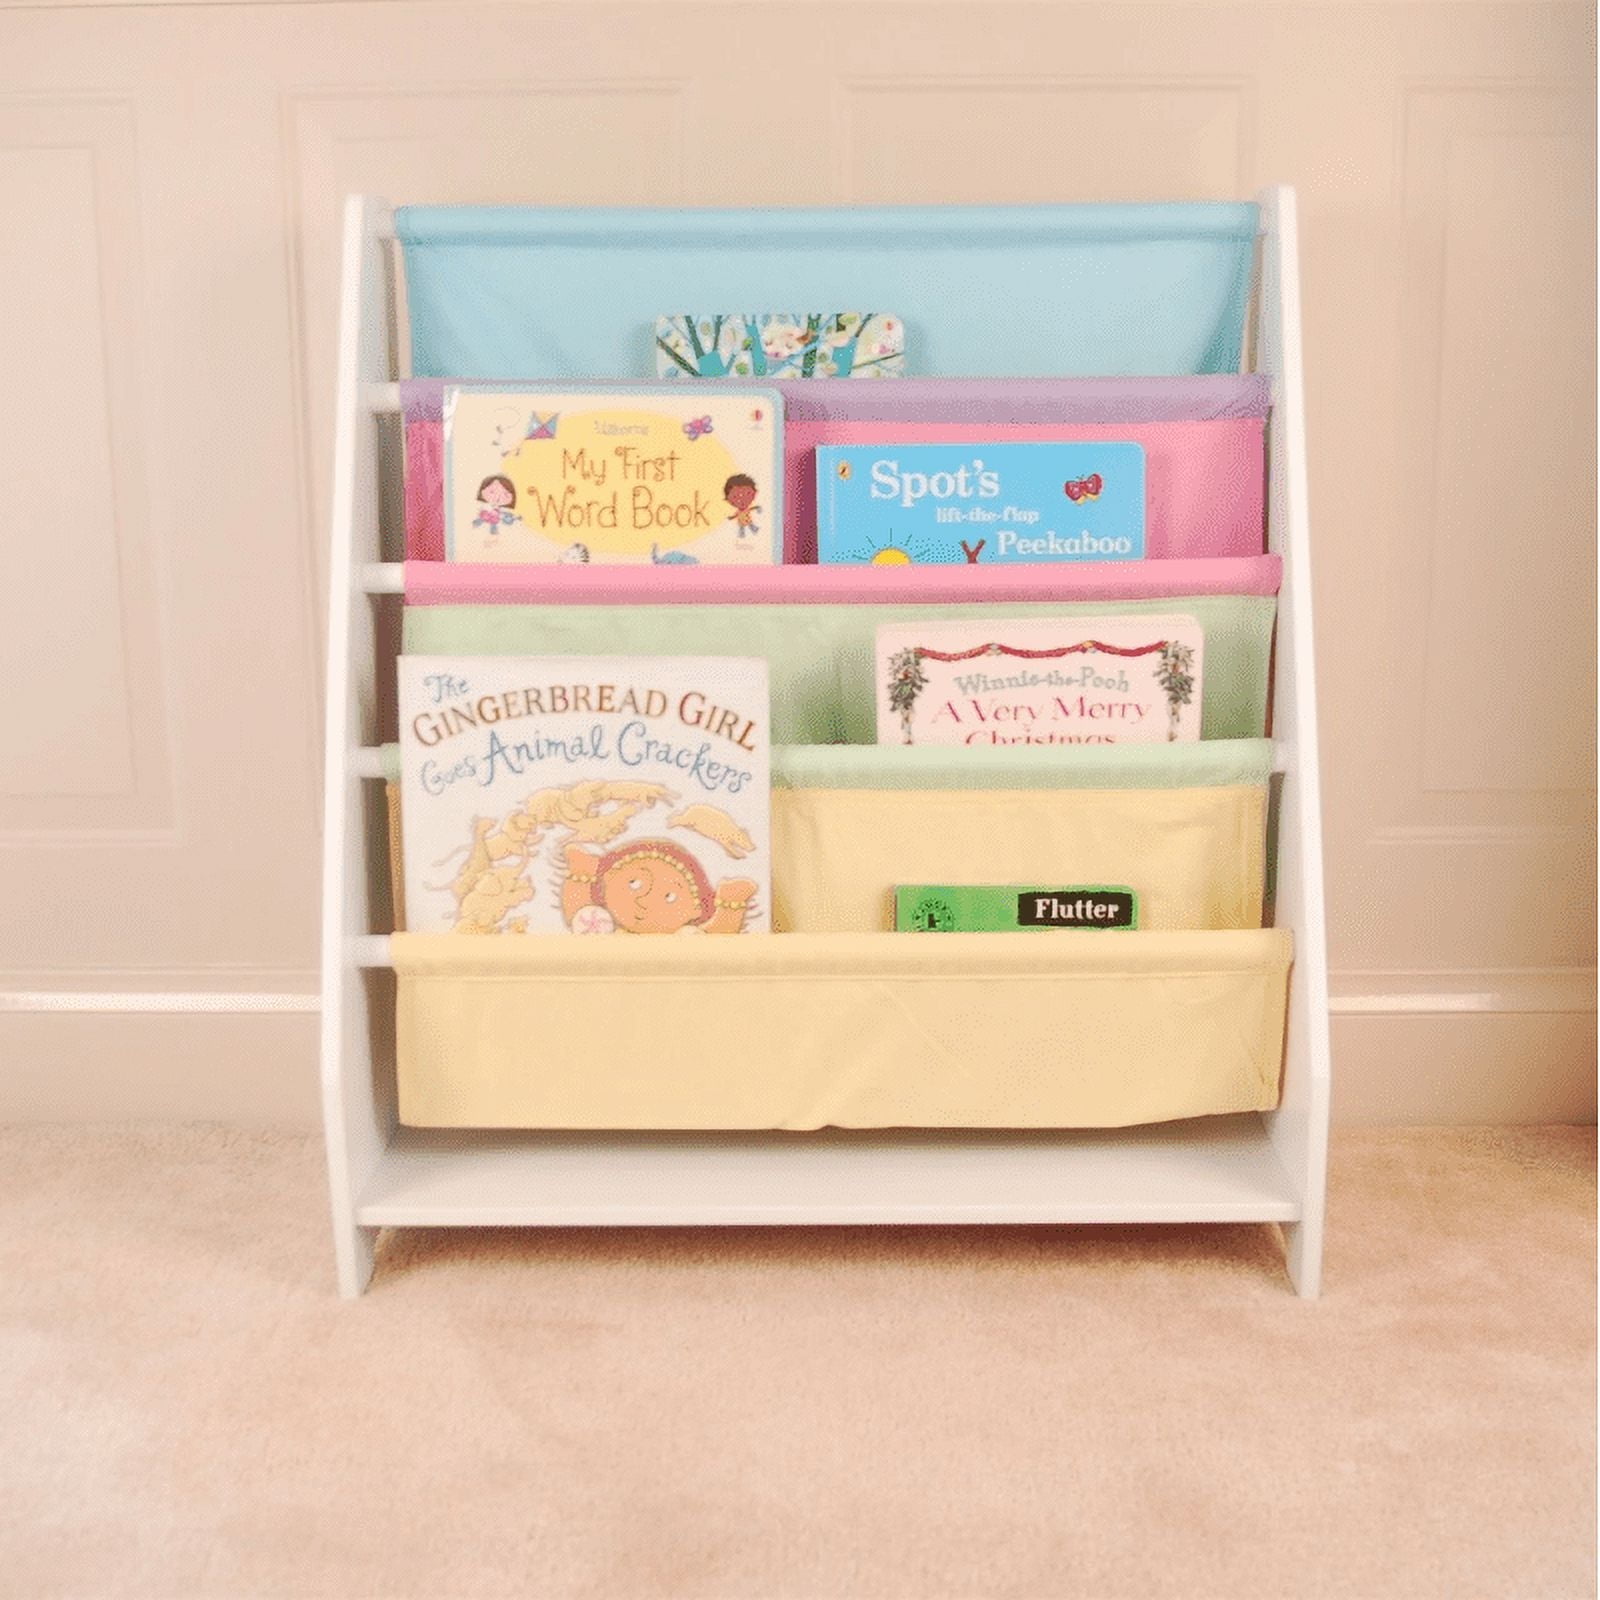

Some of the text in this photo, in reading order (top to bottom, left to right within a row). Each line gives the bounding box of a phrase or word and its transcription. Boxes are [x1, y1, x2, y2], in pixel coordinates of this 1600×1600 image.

[562, 446, 682, 486] My First
[870, 459, 1001, 507] Spot's
[527, 485, 712, 529] Word Book
[936, 506, 1040, 525] lift-the-flap
[997, 530, 1132, 556] Peekaboo
[424, 673, 471, 703] The
[953, 666, 1130, 696] Winnie-the-Pooh
[931, 695, 1152, 728] A Very Merry
[420, 721, 753, 796] Goes Animal Crackers
[1034, 898, 1120, 919] Flutter
